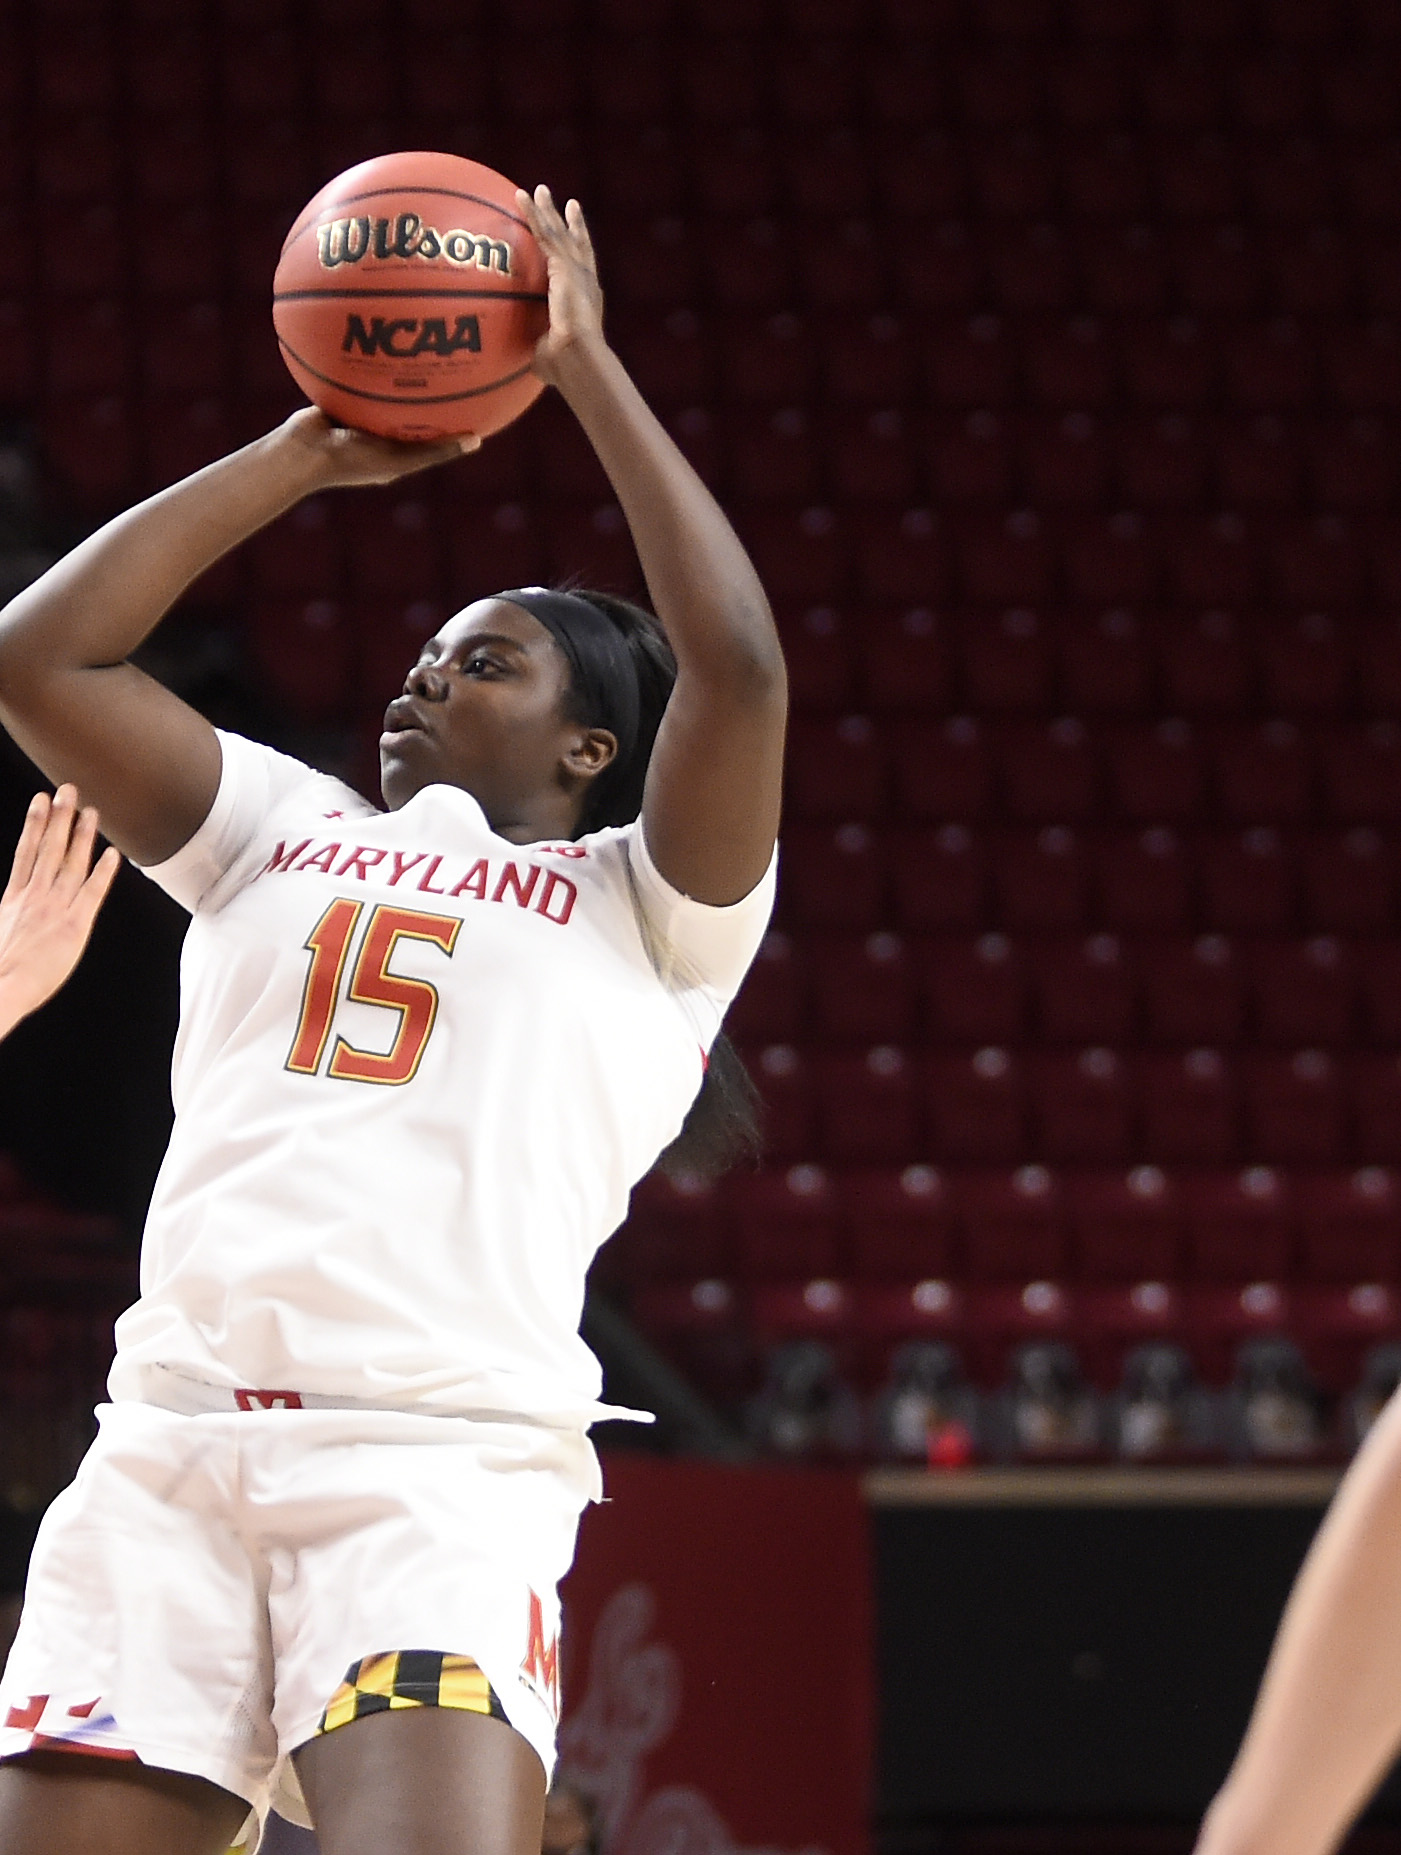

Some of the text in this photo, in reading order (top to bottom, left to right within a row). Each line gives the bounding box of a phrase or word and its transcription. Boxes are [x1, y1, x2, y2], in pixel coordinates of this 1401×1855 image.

[317, 213, 514, 278] Wilson
[342, 313, 482, 357] NCAA
[250, 838, 578, 926] MARYLAND
[284, 896, 465, 1086] 15
